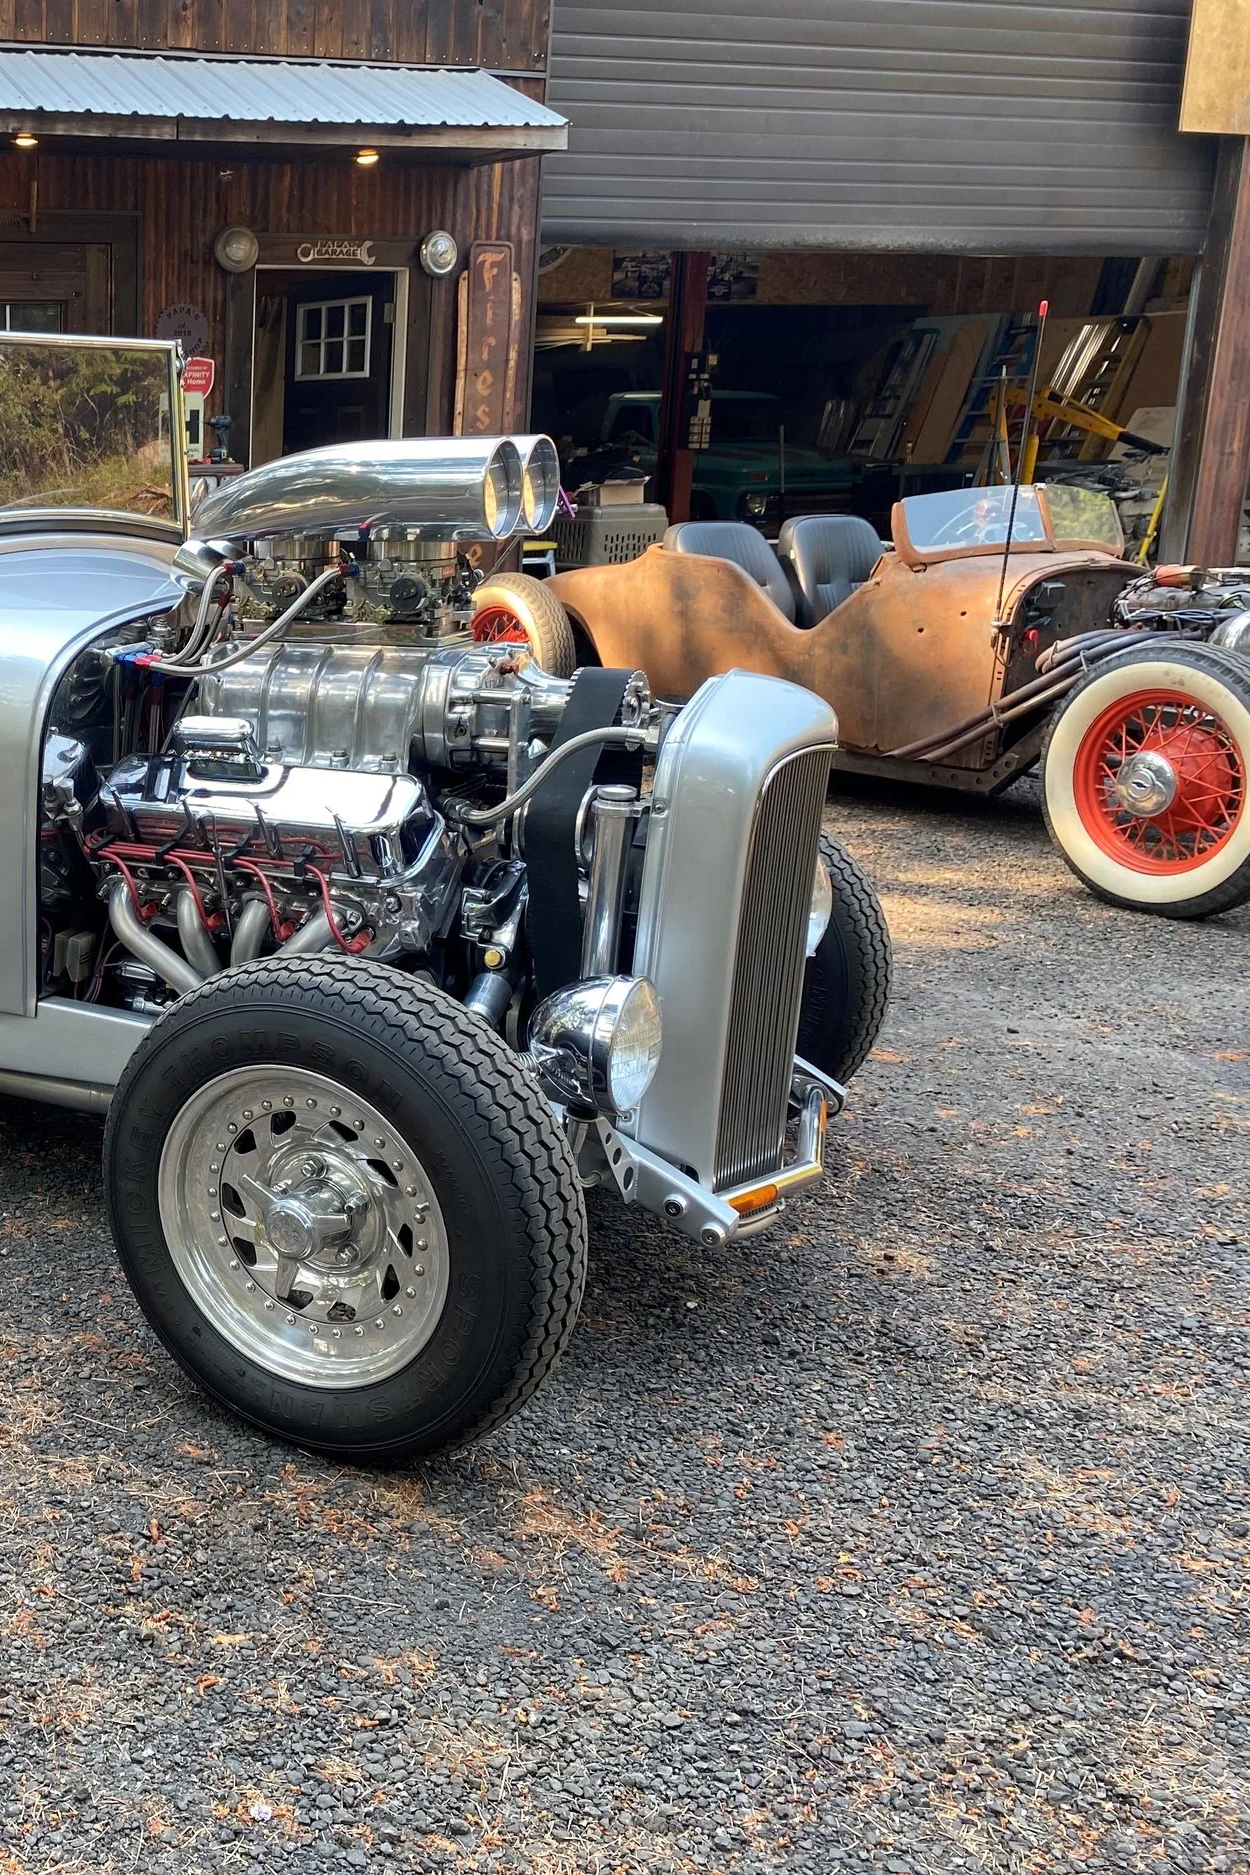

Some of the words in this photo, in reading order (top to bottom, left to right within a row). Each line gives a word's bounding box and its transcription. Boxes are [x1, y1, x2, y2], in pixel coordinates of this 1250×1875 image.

[316, 248, 359, 257] GARAGE
[125, 1096, 164, 1277] MICKEY
[160, 1028, 407, 1116] THOMPSON
[269, 1270, 483, 1429] SPORTSMAN
